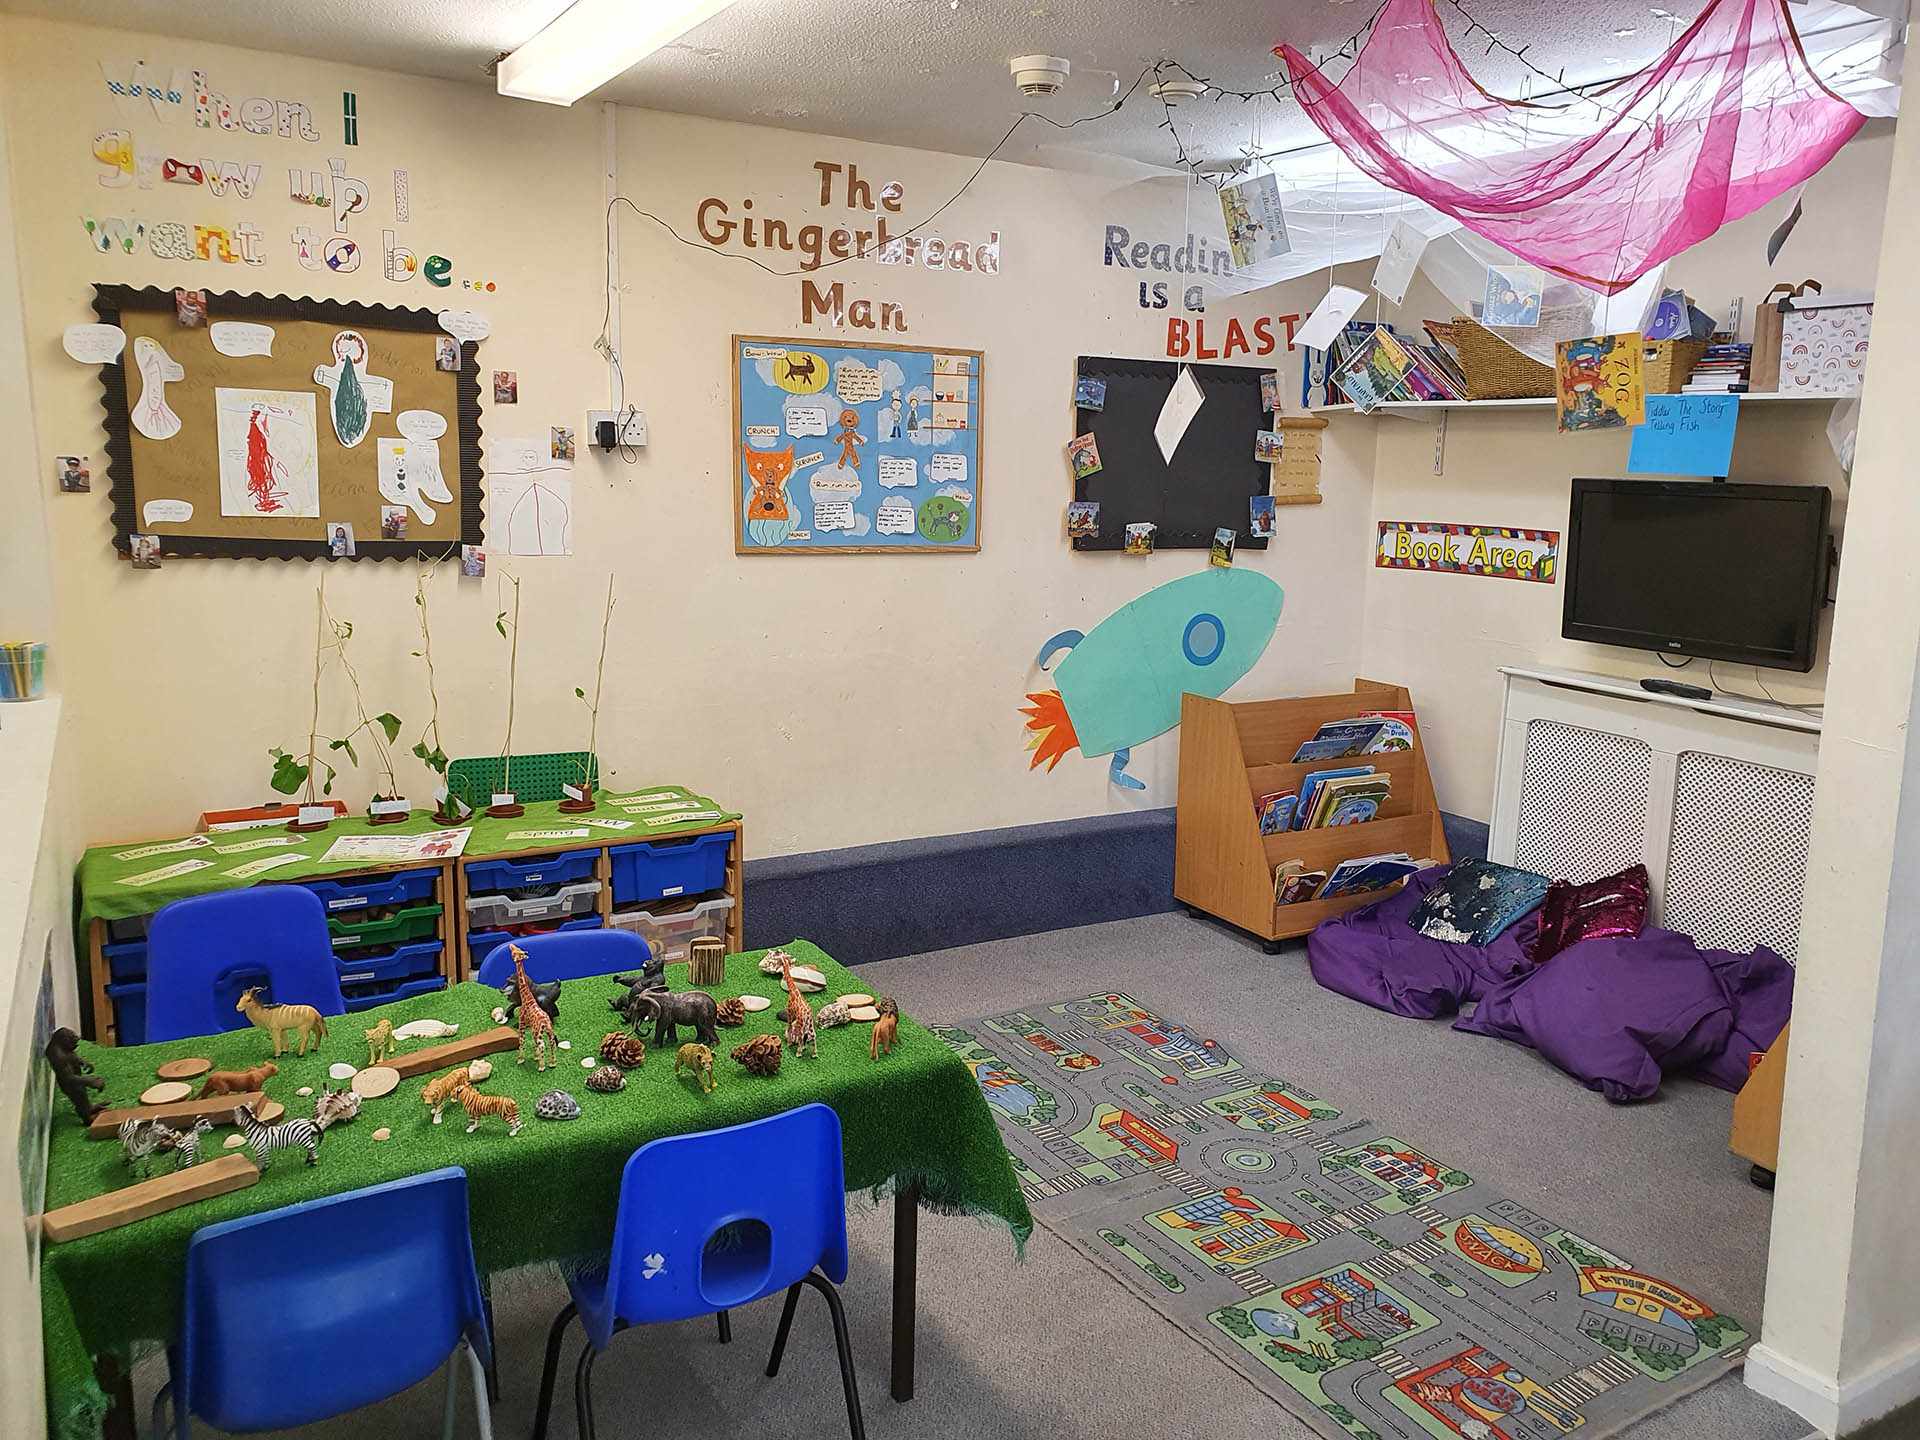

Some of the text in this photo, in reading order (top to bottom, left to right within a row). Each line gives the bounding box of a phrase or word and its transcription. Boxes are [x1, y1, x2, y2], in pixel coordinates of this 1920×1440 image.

[97, 57, 359, 146] When I
[91, 128, 409, 234] grow up I
[813, 160, 905, 213] The
[80, 215, 267, 268] want
[290, 224, 362, 274] to
[696, 197, 1001, 275] Gingerbread
[1103, 224, 1235, 278] Readin
[801, 278, 909, 333] Man
[1138, 281, 1205, 313] is a
[1613, 357, 1632, 404] ZOG
[1649, 416, 1700, 435] Telling Fish
[1679, 398, 1692, 416] The
[1699, 397, 1731, 420] Story
[1395, 530, 1534, 571] Book Area
[1458, 1230, 1515, 1272] SNACK
